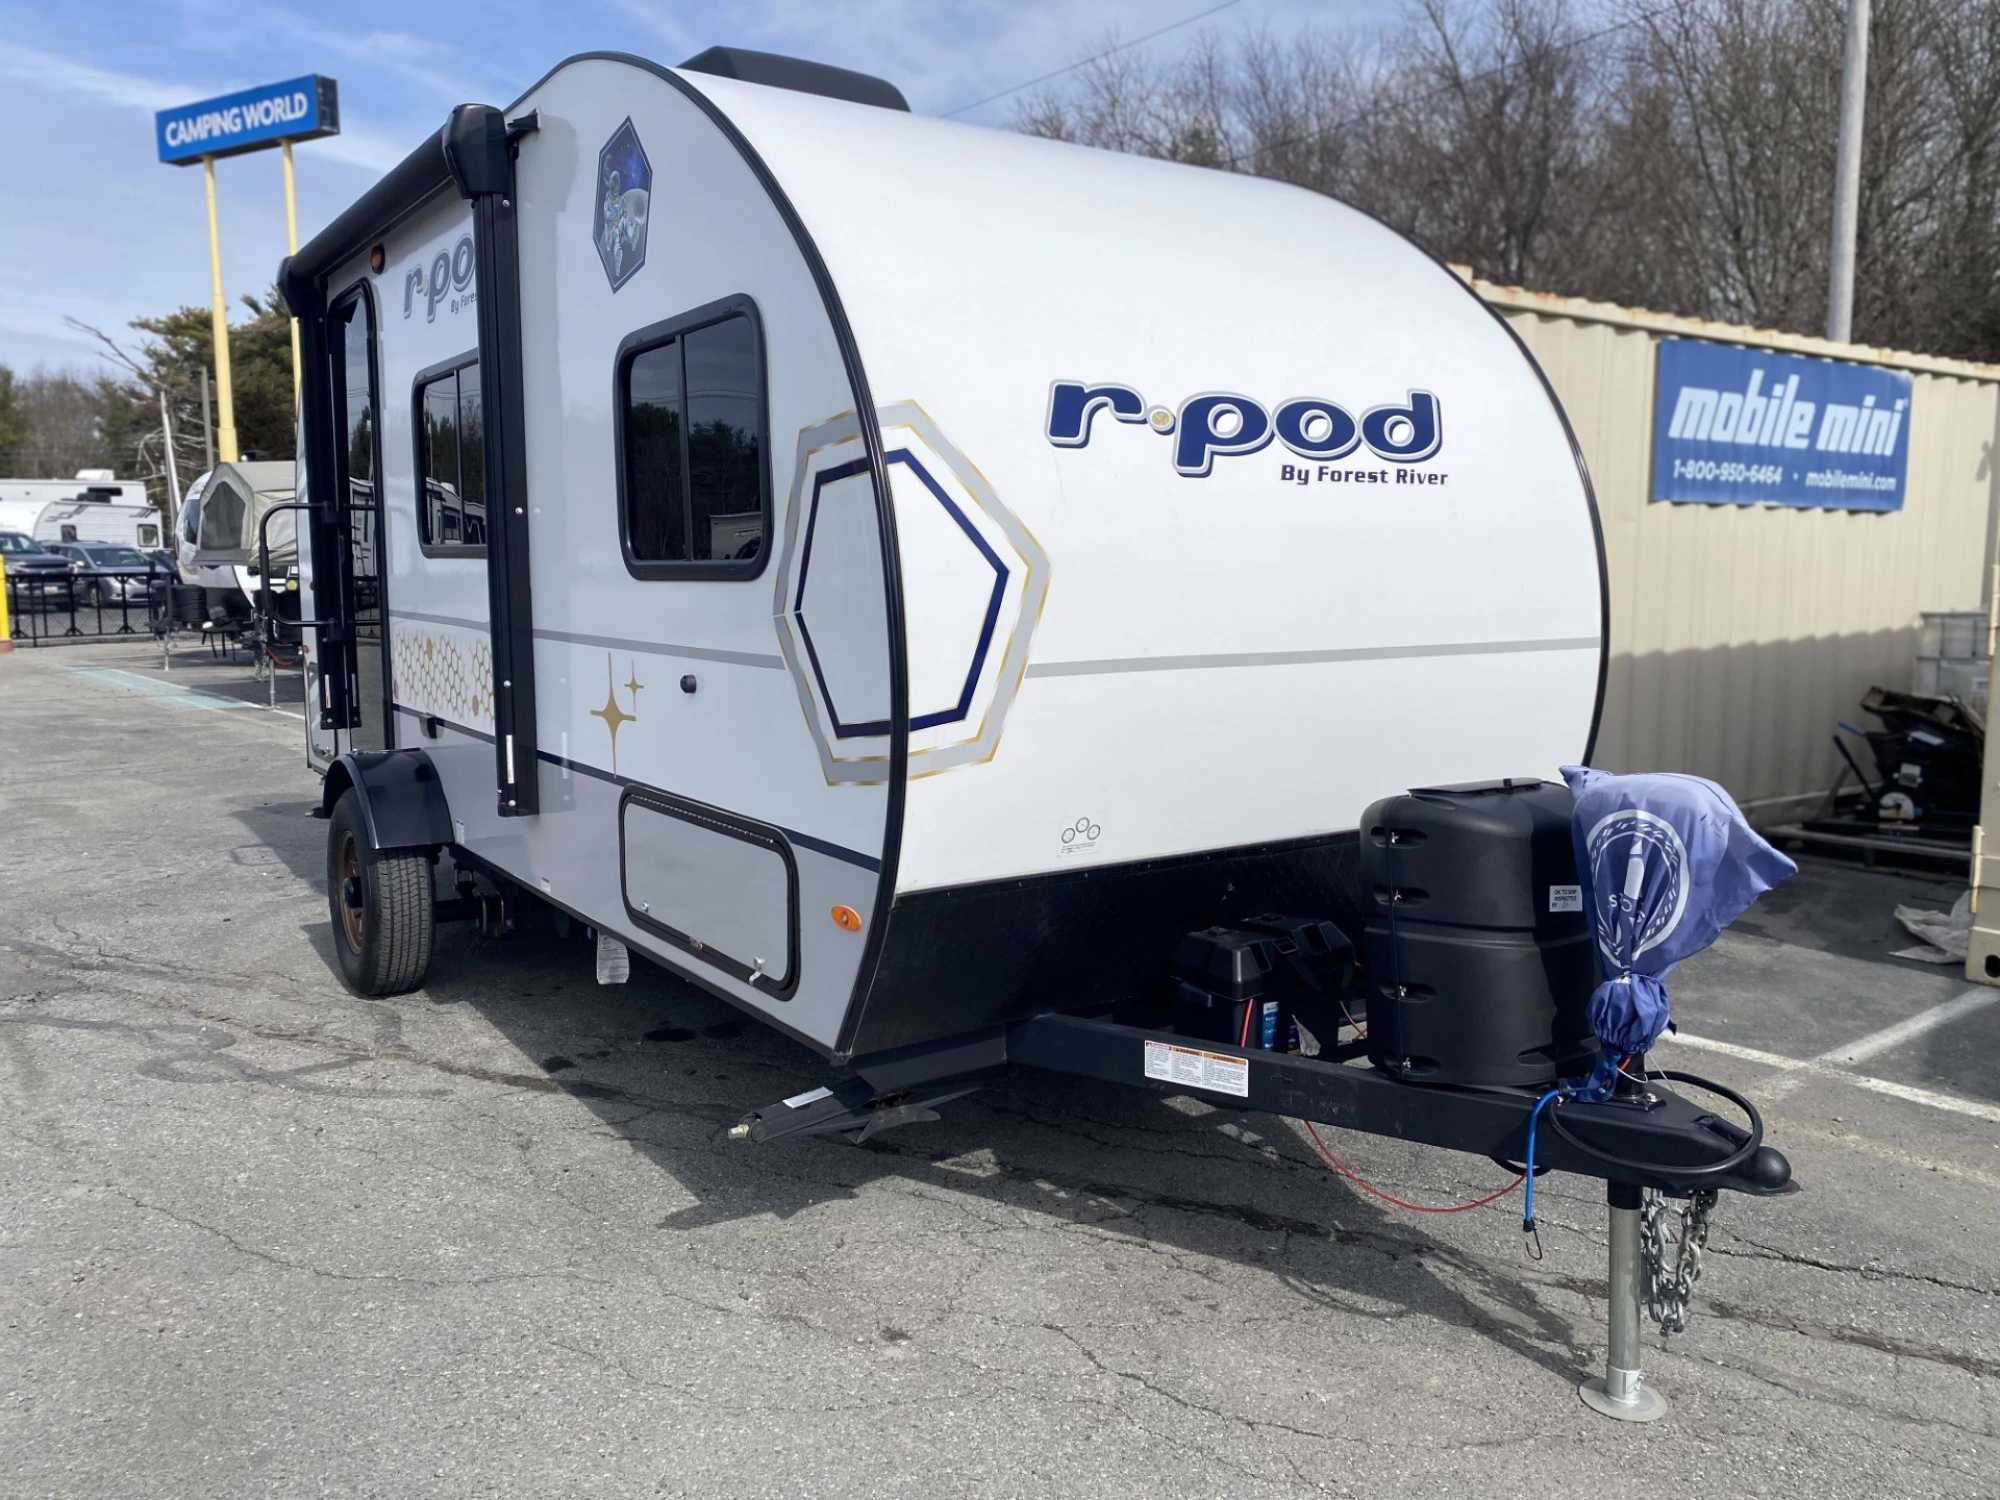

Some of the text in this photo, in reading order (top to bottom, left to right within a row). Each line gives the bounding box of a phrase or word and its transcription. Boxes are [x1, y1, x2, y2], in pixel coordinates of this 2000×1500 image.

[165, 93, 308, 146] CAMPING WORLD
[1667, 368, 1906, 457] mobile mini
[1281, 464, 1449, 486] By Forest River
[1673, 460, 1897, 491] 1-800-950-6464 mobilemini.com
